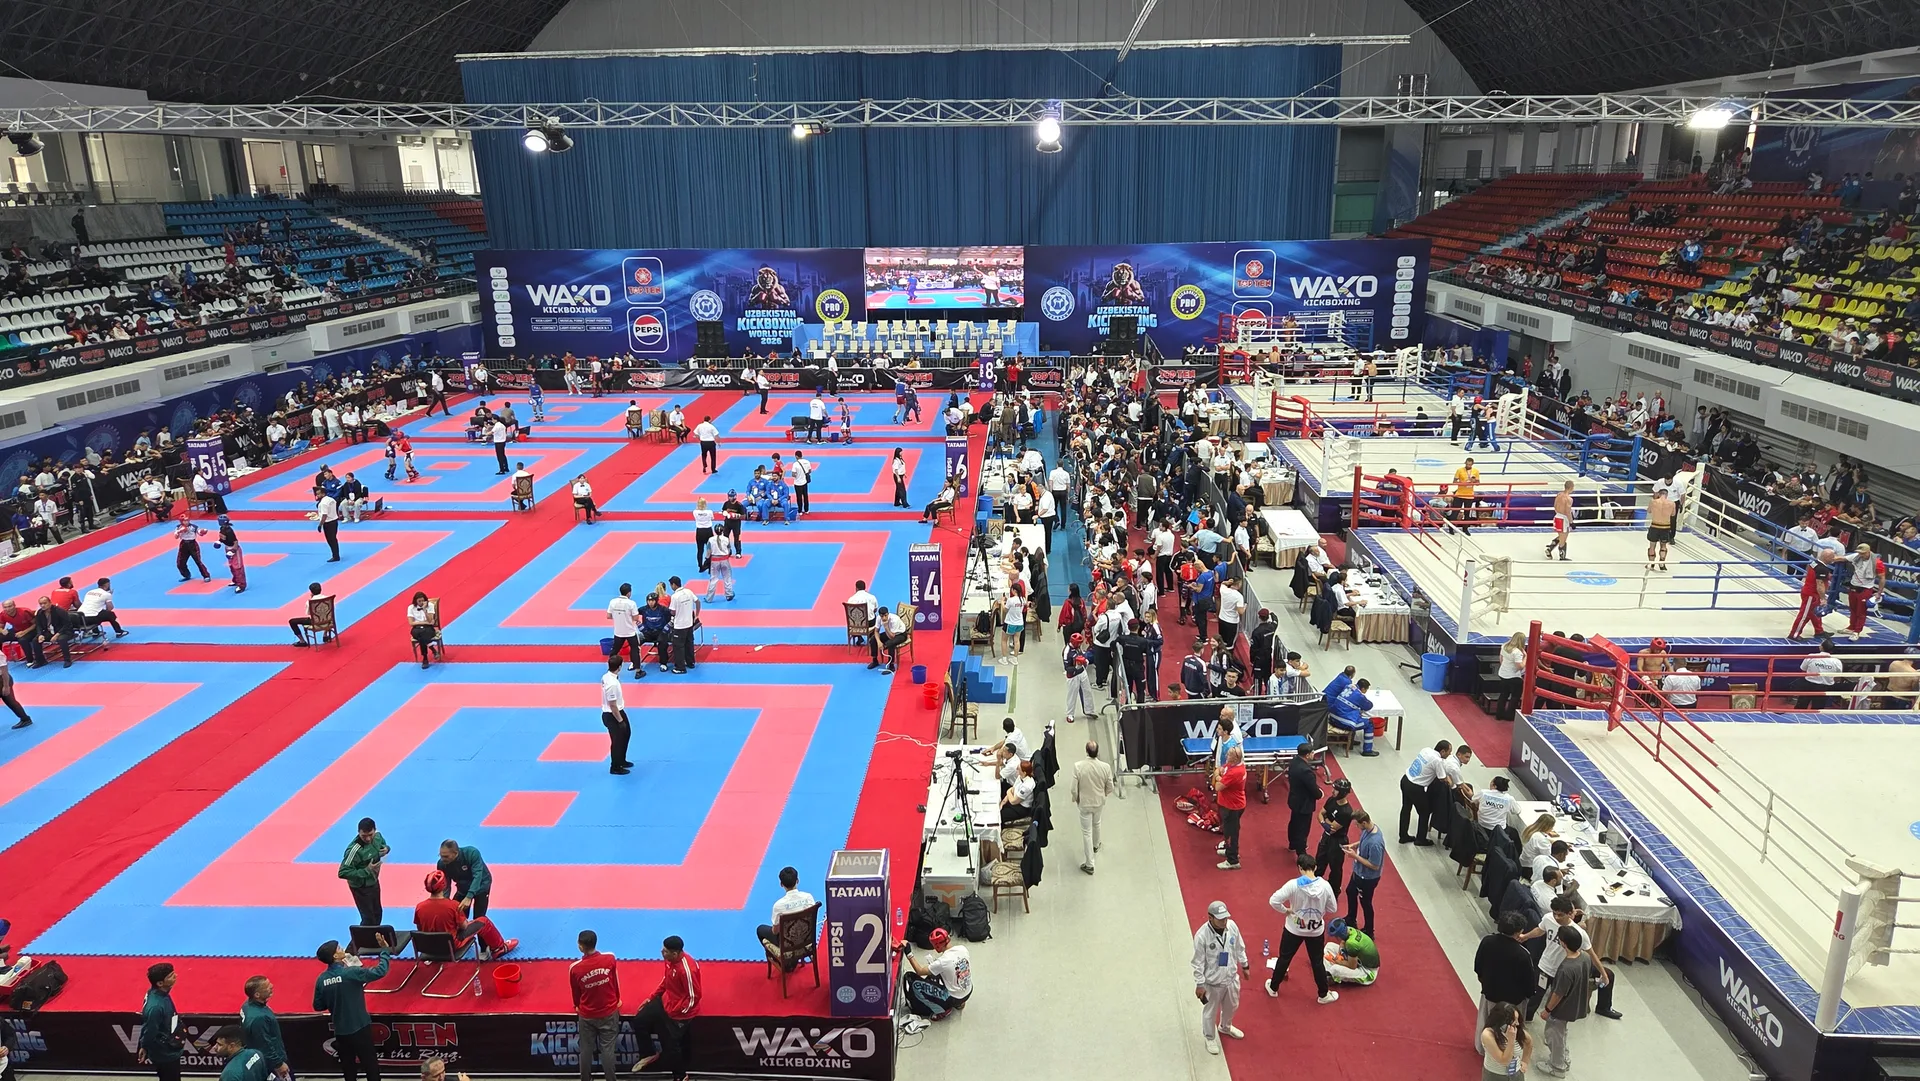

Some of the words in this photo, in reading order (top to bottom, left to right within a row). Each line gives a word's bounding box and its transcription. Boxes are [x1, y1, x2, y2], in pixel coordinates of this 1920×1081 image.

[628, 286, 645, 295] TOP
[645, 286, 662, 295] TEN
[1237, 280, 1253, 288] TOP
[1254, 280, 1272, 288] TEN
[1289, 275, 1378, 299] WAKO
[525, 285, 611, 306] WAKO
[824, 303, 840, 312] PRO
[1180, 298, 1196, 307] PRO
[1303, 298, 1361, 307] KICKBOXING
[543, 306, 598, 314] KICKBOXING
[744, 310, 796, 318] UZBEKISTAN
[1096, 306, 1150, 315] UZBEKISTAN
[288, 313, 307, 324] WAKO
[1087, 314, 1158, 328] KICING
[1650, 318, 1668, 331] WAKO
[250, 320, 269, 331] WAKO
[635, 326, 662, 334] PEPSI
[207, 327, 229, 339] WAKO
[748, 330, 778, 338] WORLD
[1689, 326, 1709, 340] WAKO
[161, 336, 183, 348] WAKO
[1731, 337, 1752, 351] WAKO
[107, 345, 134, 359] WAKO
[1779, 348, 1803, 364] WAKO
[49, 355, 77, 370] WAKO
[1833, 361, 1861, 377] WAKO
[0, 367, 14, 380] KO
[631, 373, 648, 381] TOP
[781, 373, 800, 381] TEN
[985, 361, 994, 380] 8
[1159, 370, 1177, 378] TOP
[1177, 370, 1196, 378] TEN
[696, 374, 732, 384] WAKO
[914, 373, 933, 382] TEN
[1895, 375, 1920, 393] WAK
[198, 454, 213, 480] 5
[216, 451, 227, 477] 5
[955, 454, 968, 480] 6
[1737, 489, 1772, 517] WAKO
[910, 554, 939, 562] TATAMI
[911, 575, 920, 603] PEPSI
[923, 571, 941, 606] 4
[1814, 661, 1833, 670] WAKO
[1701, 677, 1715, 687] UP
[1521, 740, 1563, 799] PEPSI
[829, 886, 881, 898] TATAMI
[831, 921, 845, 968] PEPSI
[853, 913, 885, 974] 2
[323, 975, 343, 987] IRAQ
[581, 968, 611, 983] PALESTINE
[1719, 956, 1784, 1048] WAKO
[1726, 993, 1768, 1047] KICKBOXING
[392, 1022, 459, 1047] TEN
[732, 1027, 876, 1058] WAKO
[10, 1050, 30, 1063] UP
[390, 1049, 411, 1059] the
[759, 1057, 852, 1069] KICKBOXING
